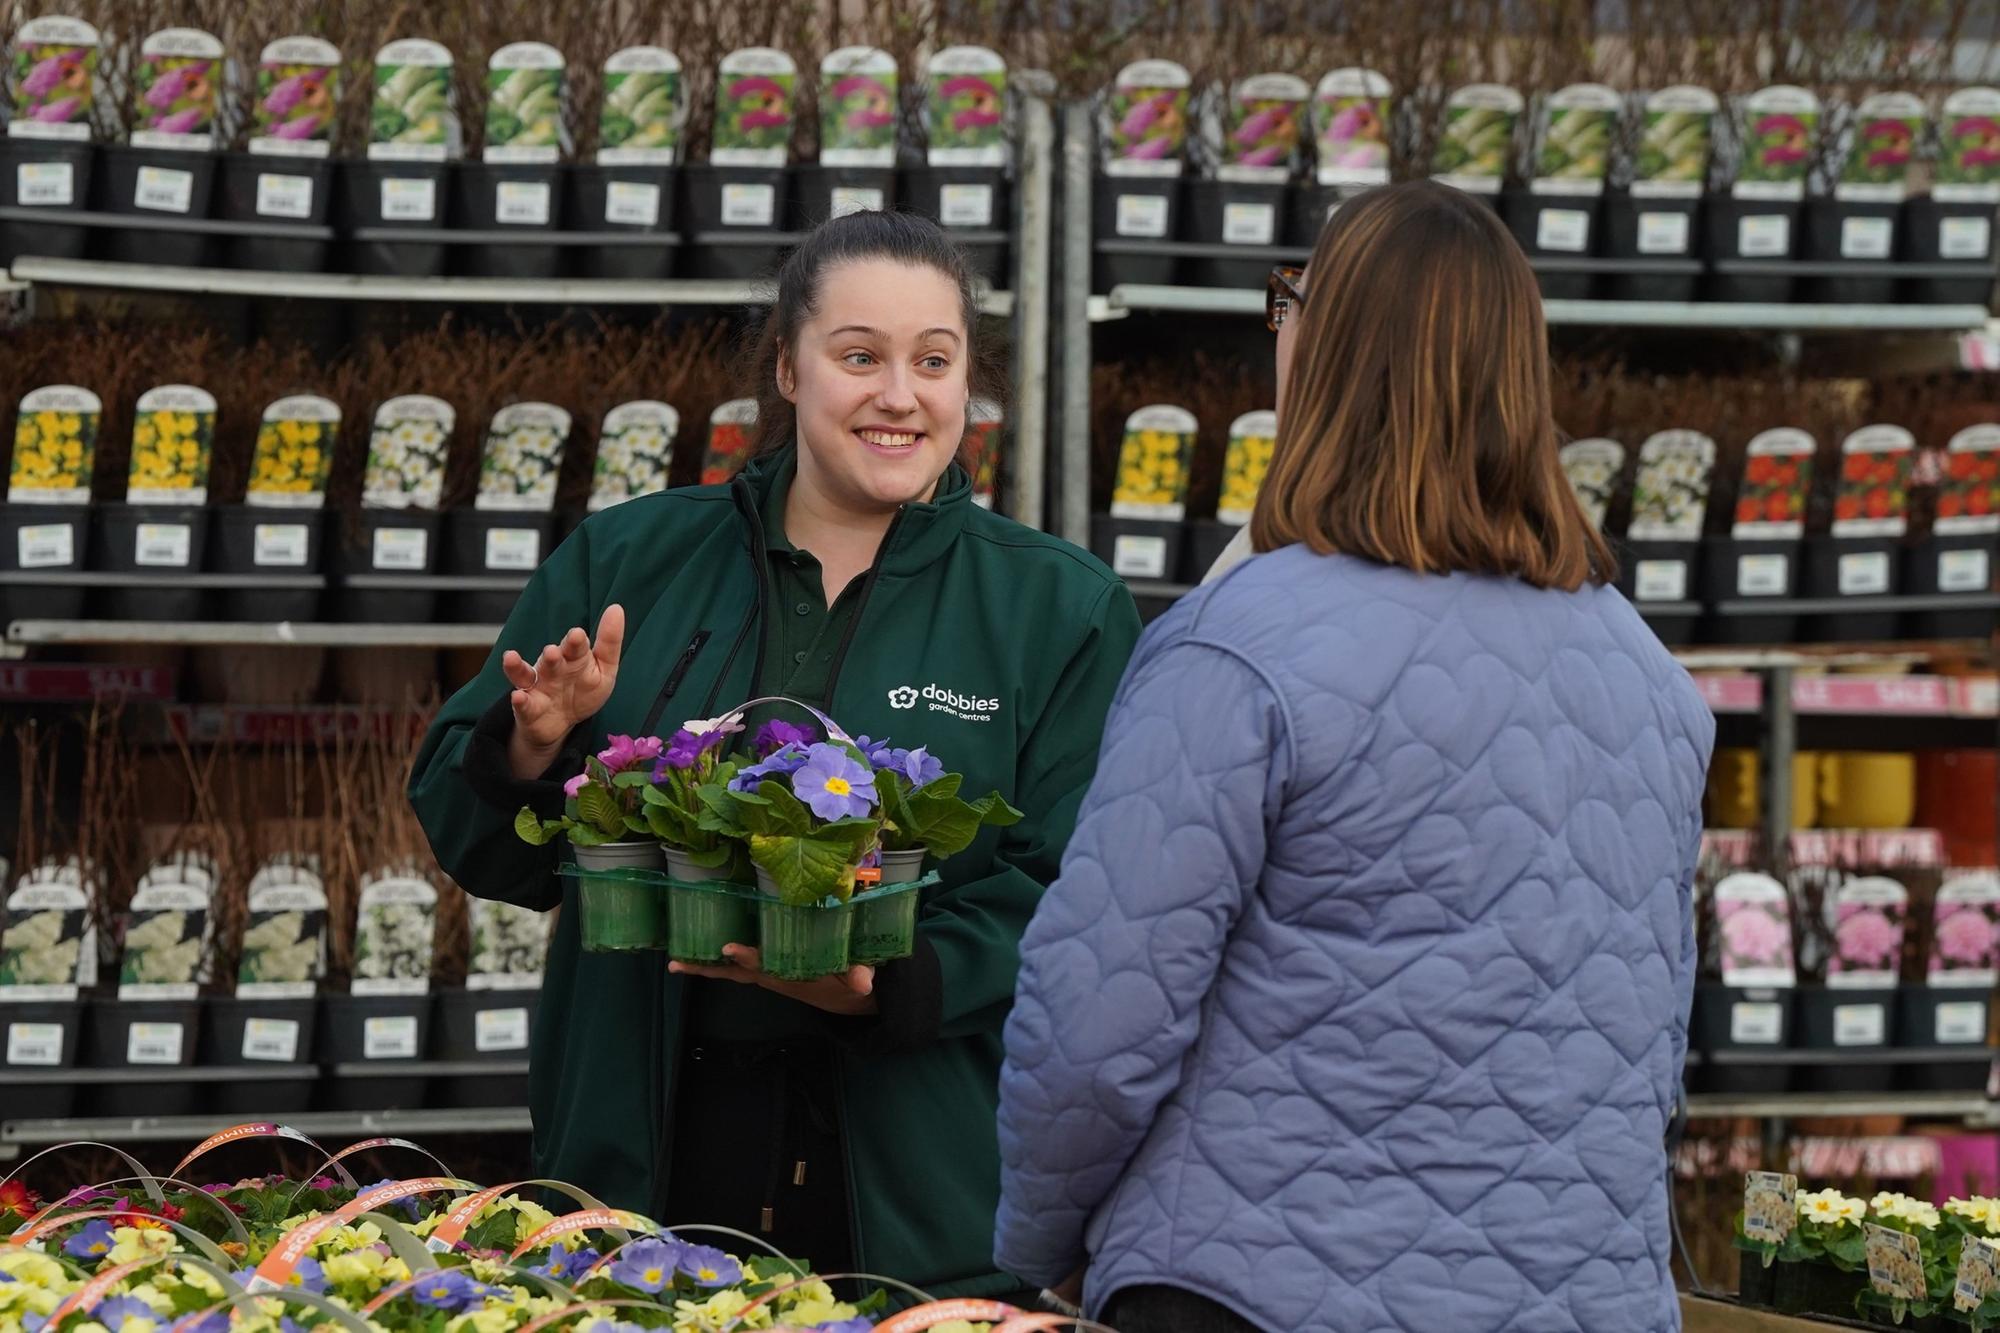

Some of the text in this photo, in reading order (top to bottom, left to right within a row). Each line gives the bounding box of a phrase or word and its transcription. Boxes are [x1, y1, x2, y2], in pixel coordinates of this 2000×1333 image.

[921, 683, 1000, 711] dobbies
[928, 702, 991, 722] garden centres
[359, 1182, 445, 1210] PRIMROSE
[530, 1216, 621, 1245] PRIMROSE
